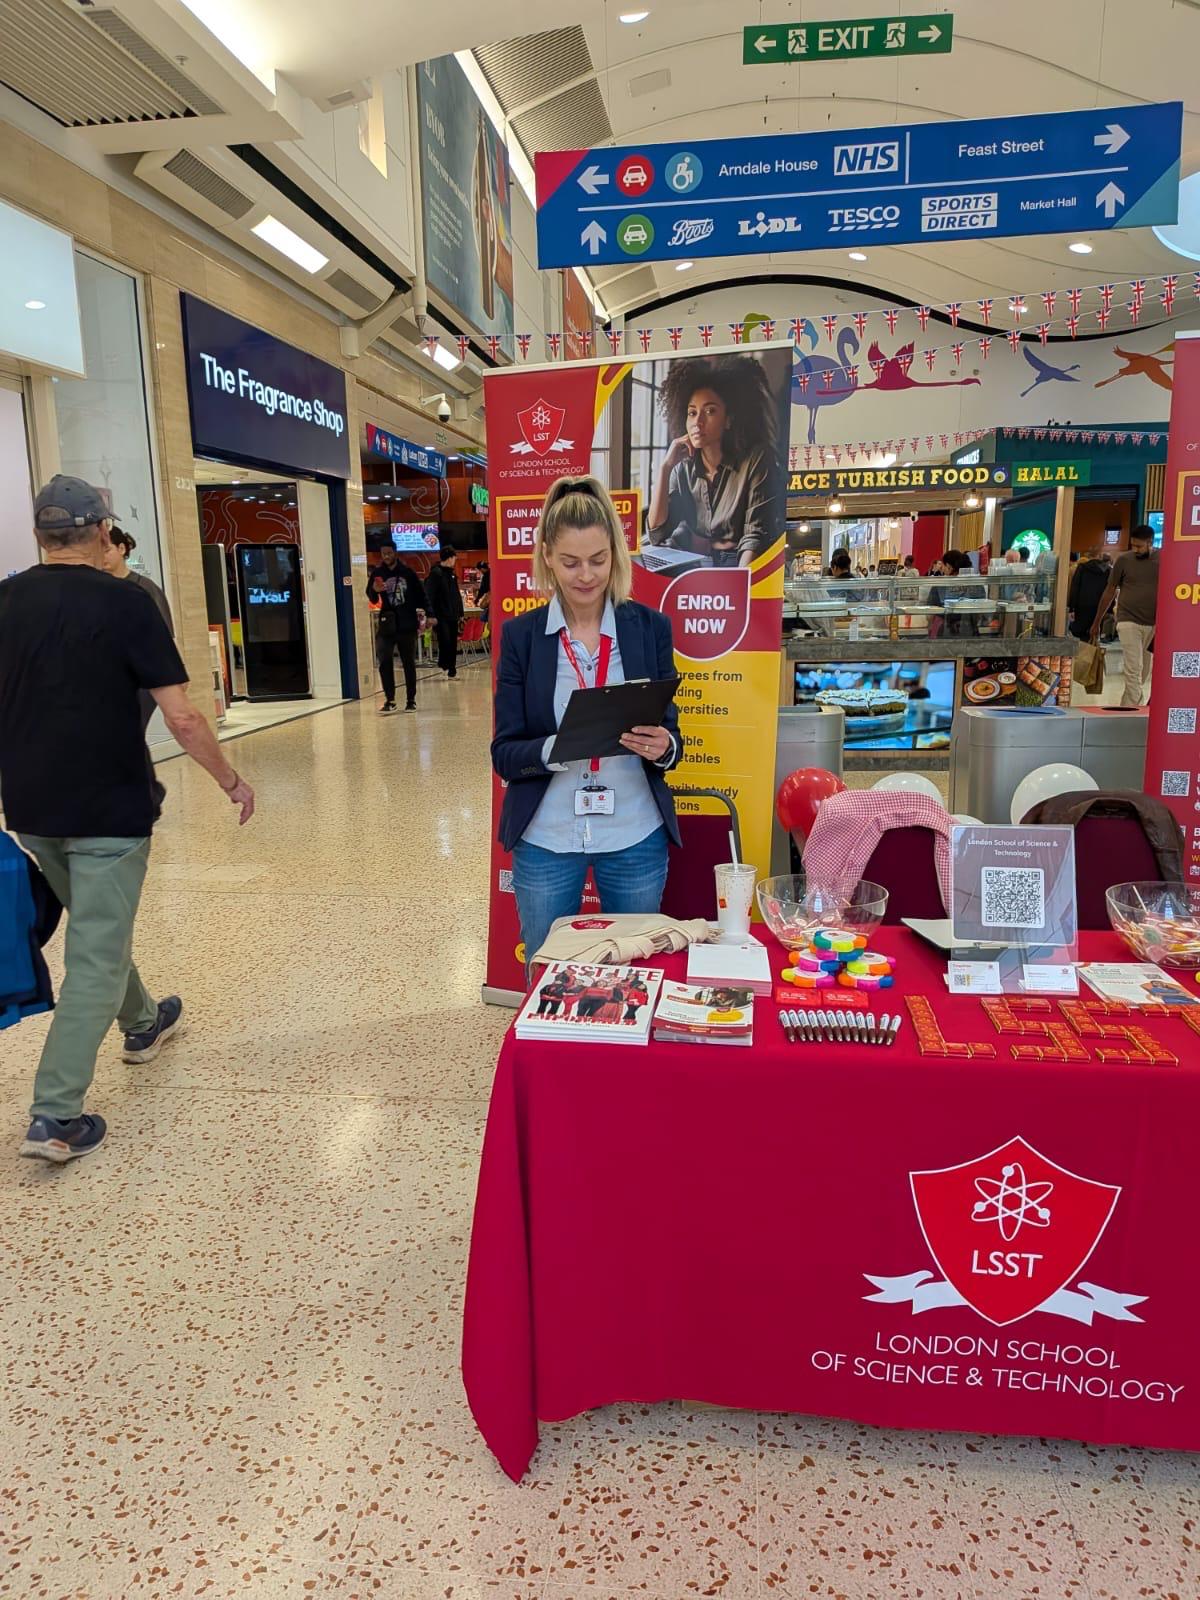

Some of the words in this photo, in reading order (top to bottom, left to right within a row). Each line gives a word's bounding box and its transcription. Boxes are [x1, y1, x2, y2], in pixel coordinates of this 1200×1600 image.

[818, 26, 875, 51] EXIT
[958, 142, 998, 158] Feast
[1001, 138, 1044, 154] Street
[837, 144, 896, 172] NHS
[719, 161, 771, 176] Arndale
[775, 158, 818, 172] House
[927, 195, 992, 212] SPORTS
[1020, 199, 1055, 211] Market
[1057, 197, 1077, 208] Hall
[828, 206, 900, 225] TESCO
[926, 213, 991, 230] DIRECT
[667, 218, 714, 246] Boots
[200, 352, 236, 394] The
[238, 367, 313, 422] Fragrance
[313, 398, 344, 438] Shop
[533, 432, 550, 442] LSST
[513, 459, 543, 468] LONDON
[544, 457, 571, 467] SCHOOL
[499, 470, 508, 478] OF
[508, 468, 534, 477] SCIENCE
[535, 468, 541, 476] &
[541, 466, 584, 476] TECHNOLOGY
[787, 473, 830, 490] ACE
[836, 470, 925, 488] TURKISH
[930, 467, 990, 486] FOOD
[1017, 466, 1079, 482] HALAL
[506, 508, 528, 518] GAIN
[390, 524, 439, 534] TOPPINGS
[677, 594, 736, 611] ENROL
[684, 618, 726, 634] NOW
[713, 670, 743, 682] from
[682, 752, 721, 764] tables
[676, 799, 700, 811] ions
[968, 838, 993, 846] London
[994, 839, 1016, 847] School
[1026, 840, 1051, 848] Science
[1052, 840, 1059, 848] &
[994, 849, 1031, 859] Technology
[551, 963, 608, 978] LSST
[971, 1249, 1043, 1278] LSST
[875, 1331, 998, 1358] LONDON
[1006, 1340, 1121, 1370] SCHOOL
[811, 1350, 847, 1372] OF
[853, 1357, 959, 1385] SCIENCE
[965, 1367, 983, 1387] &
[991, 1368, 1185, 1403] TECHNOLOGY
